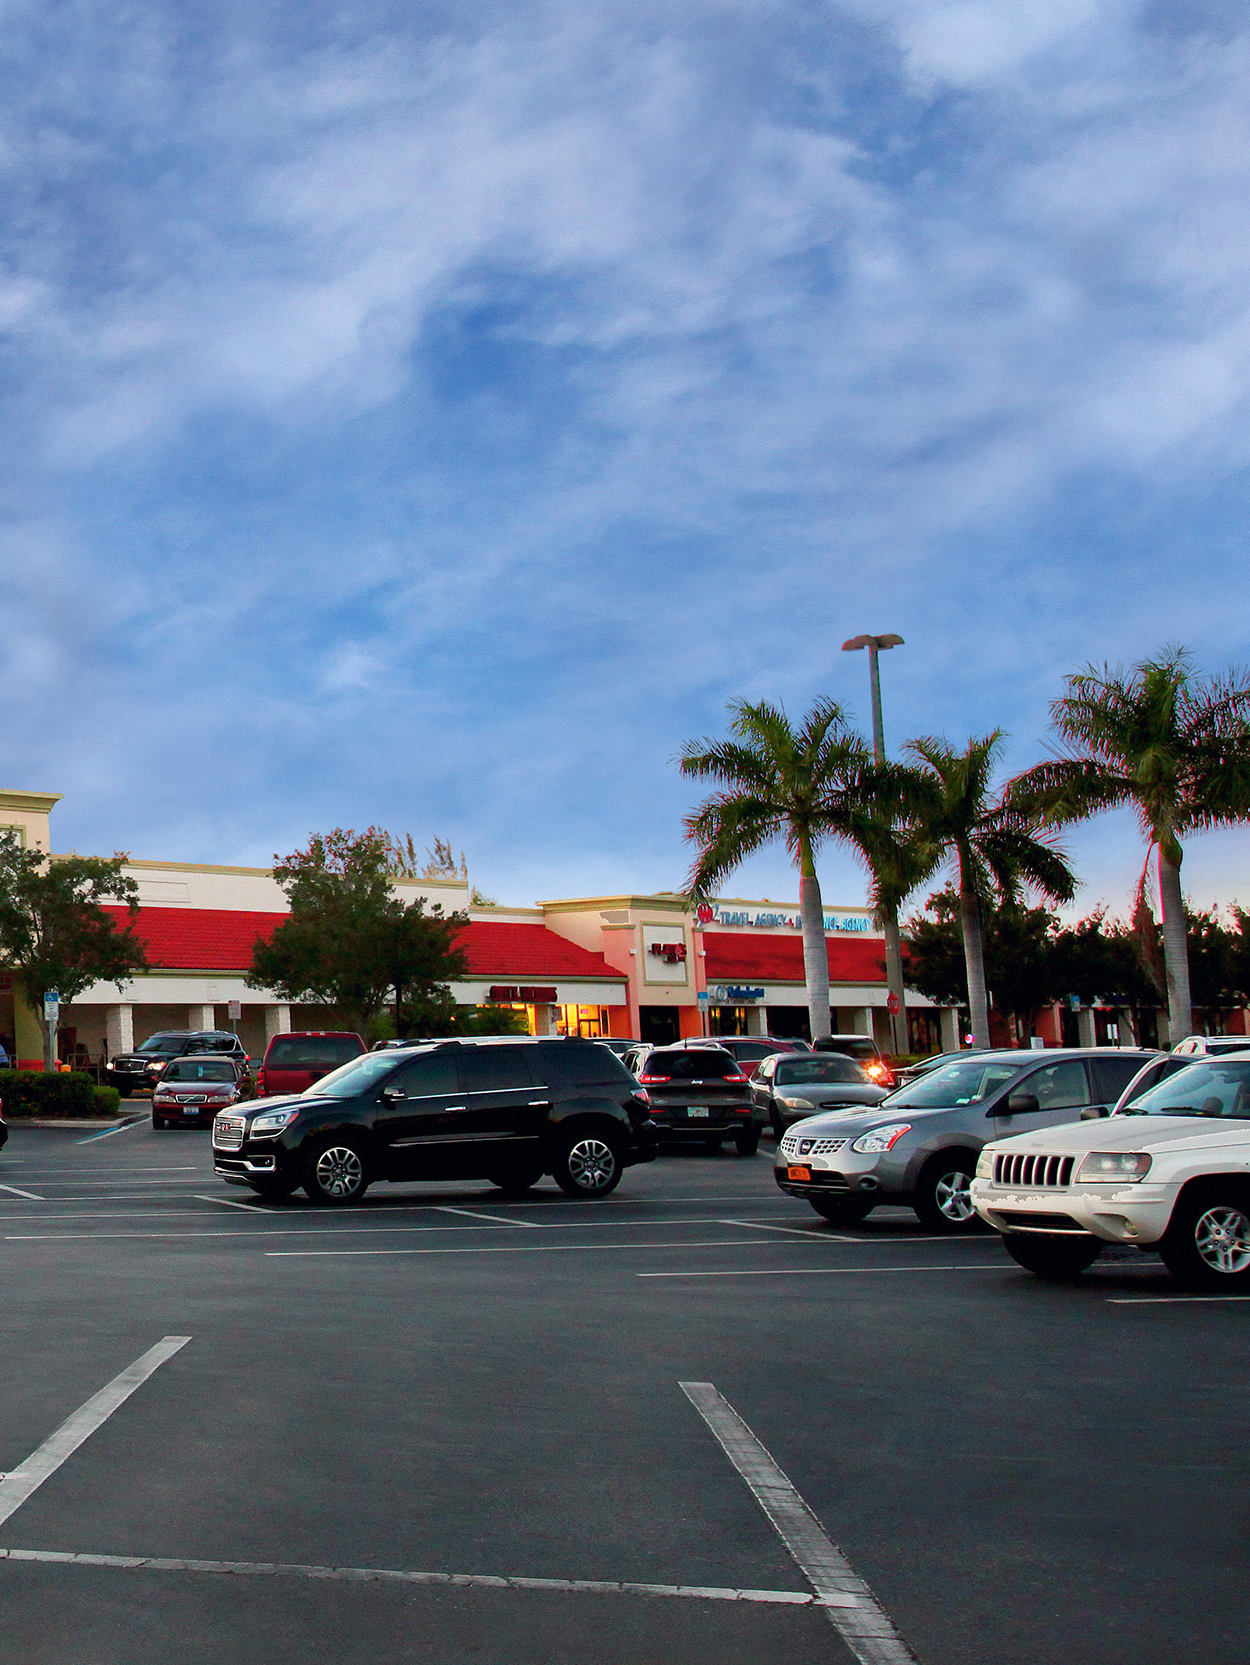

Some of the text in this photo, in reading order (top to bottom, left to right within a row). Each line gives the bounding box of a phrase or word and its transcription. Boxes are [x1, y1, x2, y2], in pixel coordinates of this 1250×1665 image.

[719, 911, 750, 926] TRAVEL
[753, 913, 787, 927] AGENCY
[840, 917, 871, 932] AGENCY
